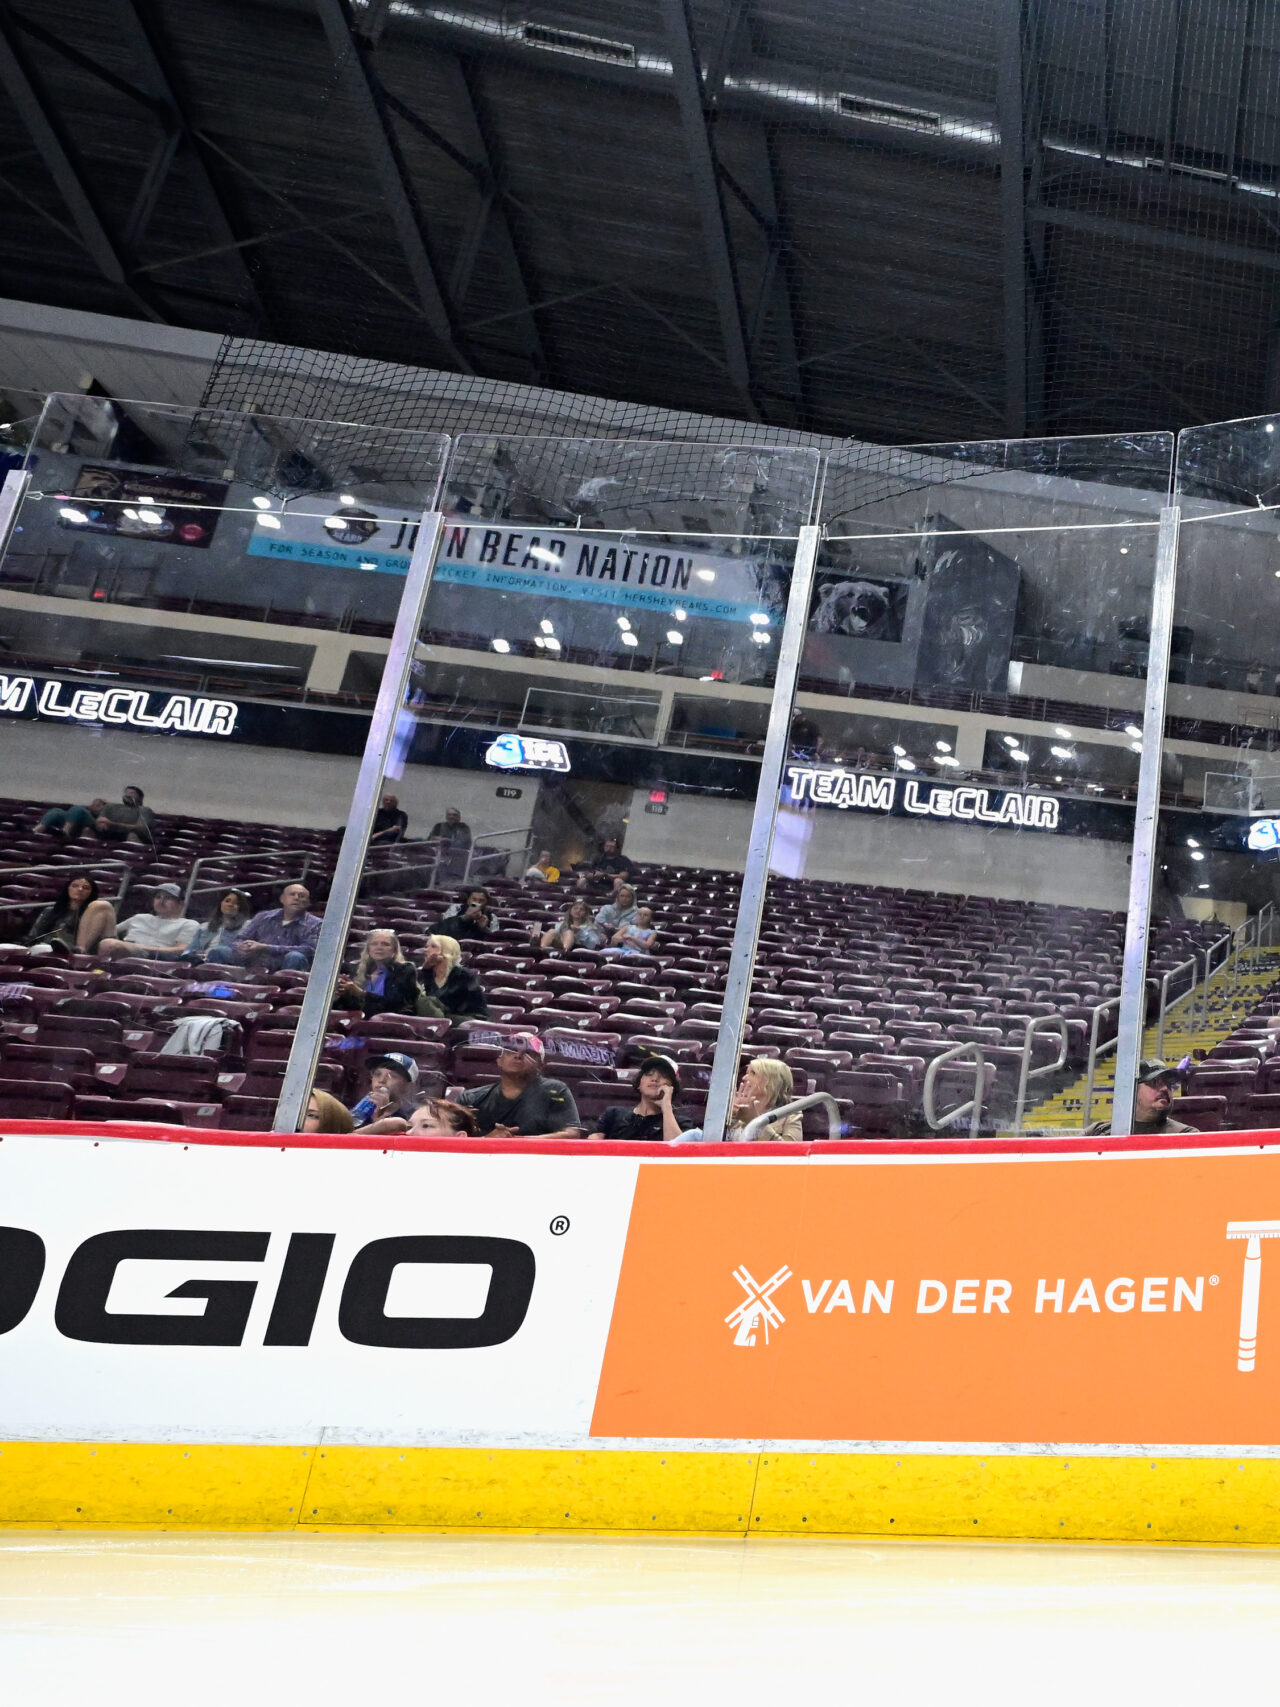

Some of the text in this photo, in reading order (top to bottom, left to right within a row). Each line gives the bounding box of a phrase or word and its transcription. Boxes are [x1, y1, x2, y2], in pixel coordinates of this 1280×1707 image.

[269, 542, 293, 554] FOR
[302, 546, 348, 563] SEASON
[576, 543, 694, 591] NATION
[788, 767, 896, 810] TEAM
[801, 1279, 895, 1314] VAN
[916, 1279, 1013, 1314] DER
